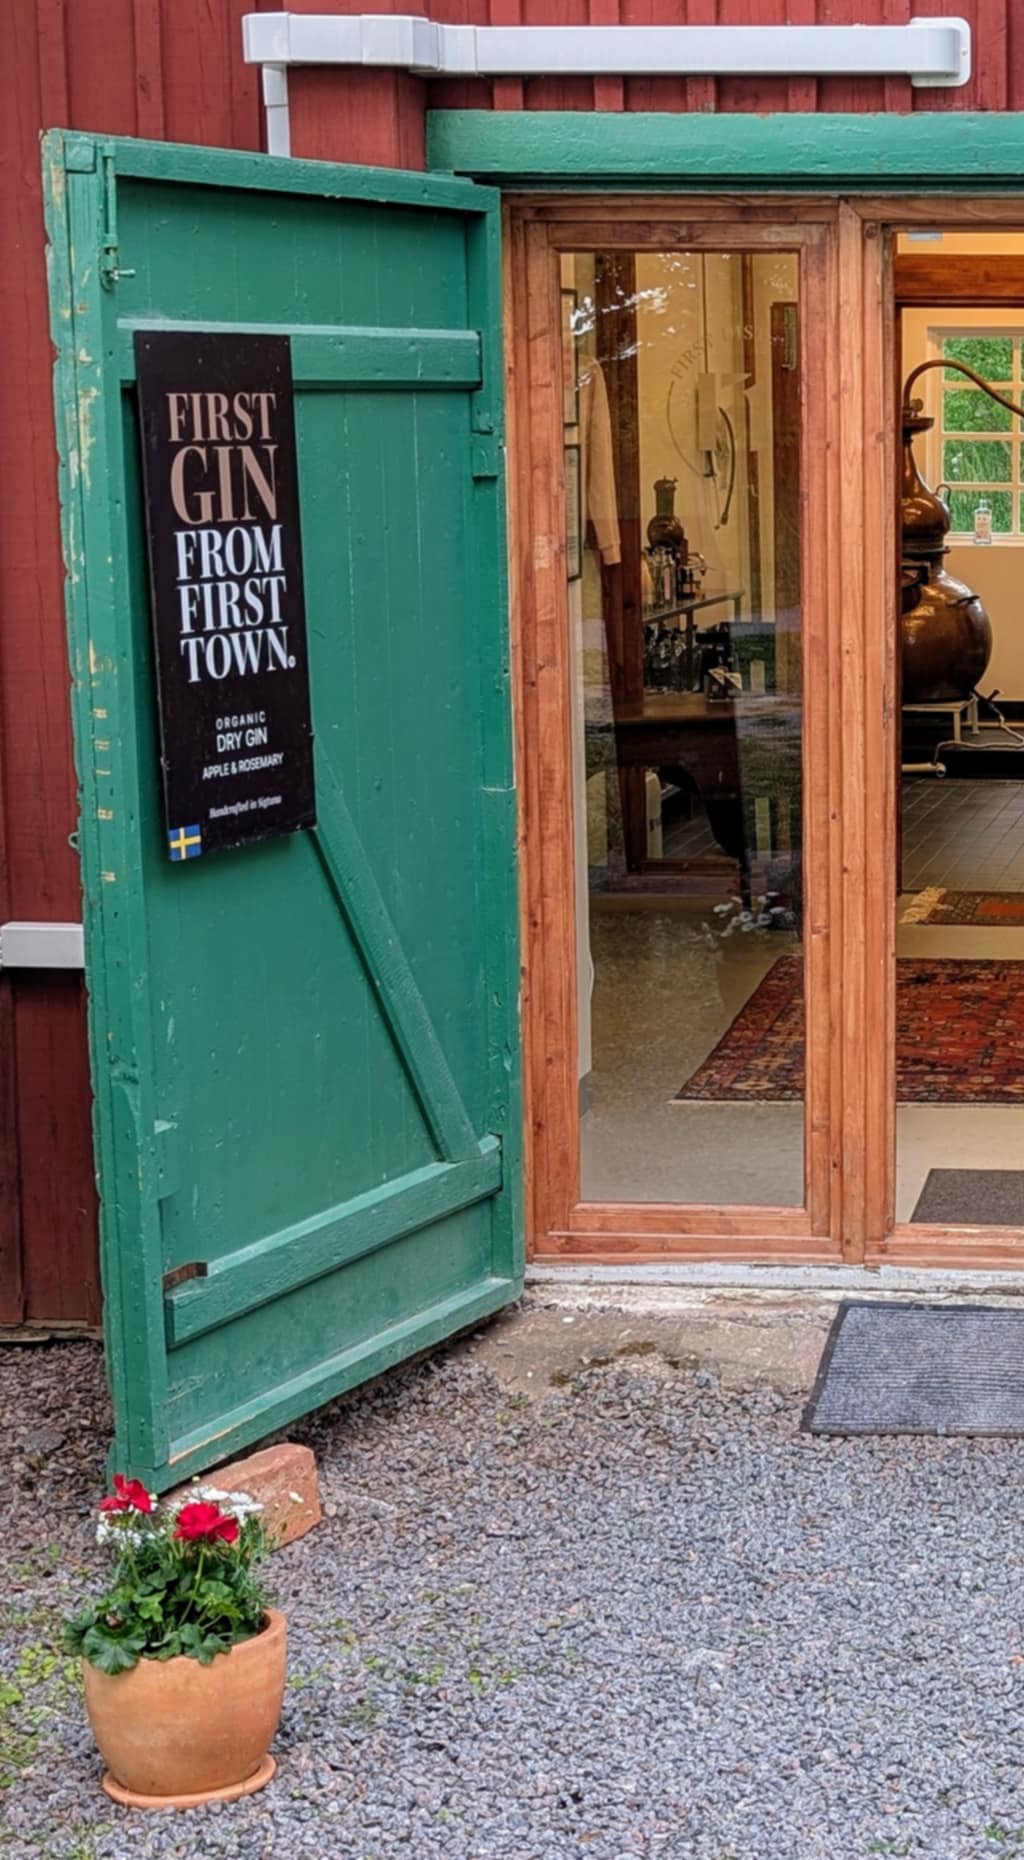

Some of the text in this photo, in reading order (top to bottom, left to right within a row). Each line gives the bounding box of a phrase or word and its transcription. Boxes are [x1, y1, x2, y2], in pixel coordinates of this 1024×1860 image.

[166, 392, 277, 442] FIRST
[170, 444, 279, 525] GIN
[173, 524, 284, 581] FROM
[176, 576, 287, 634] FIRST
[215, 710, 266, 730] ORGANIC
[216, 727, 268, 752] DRY GIN
[202, 752, 284, 780] APPLE & ROSEMARY
